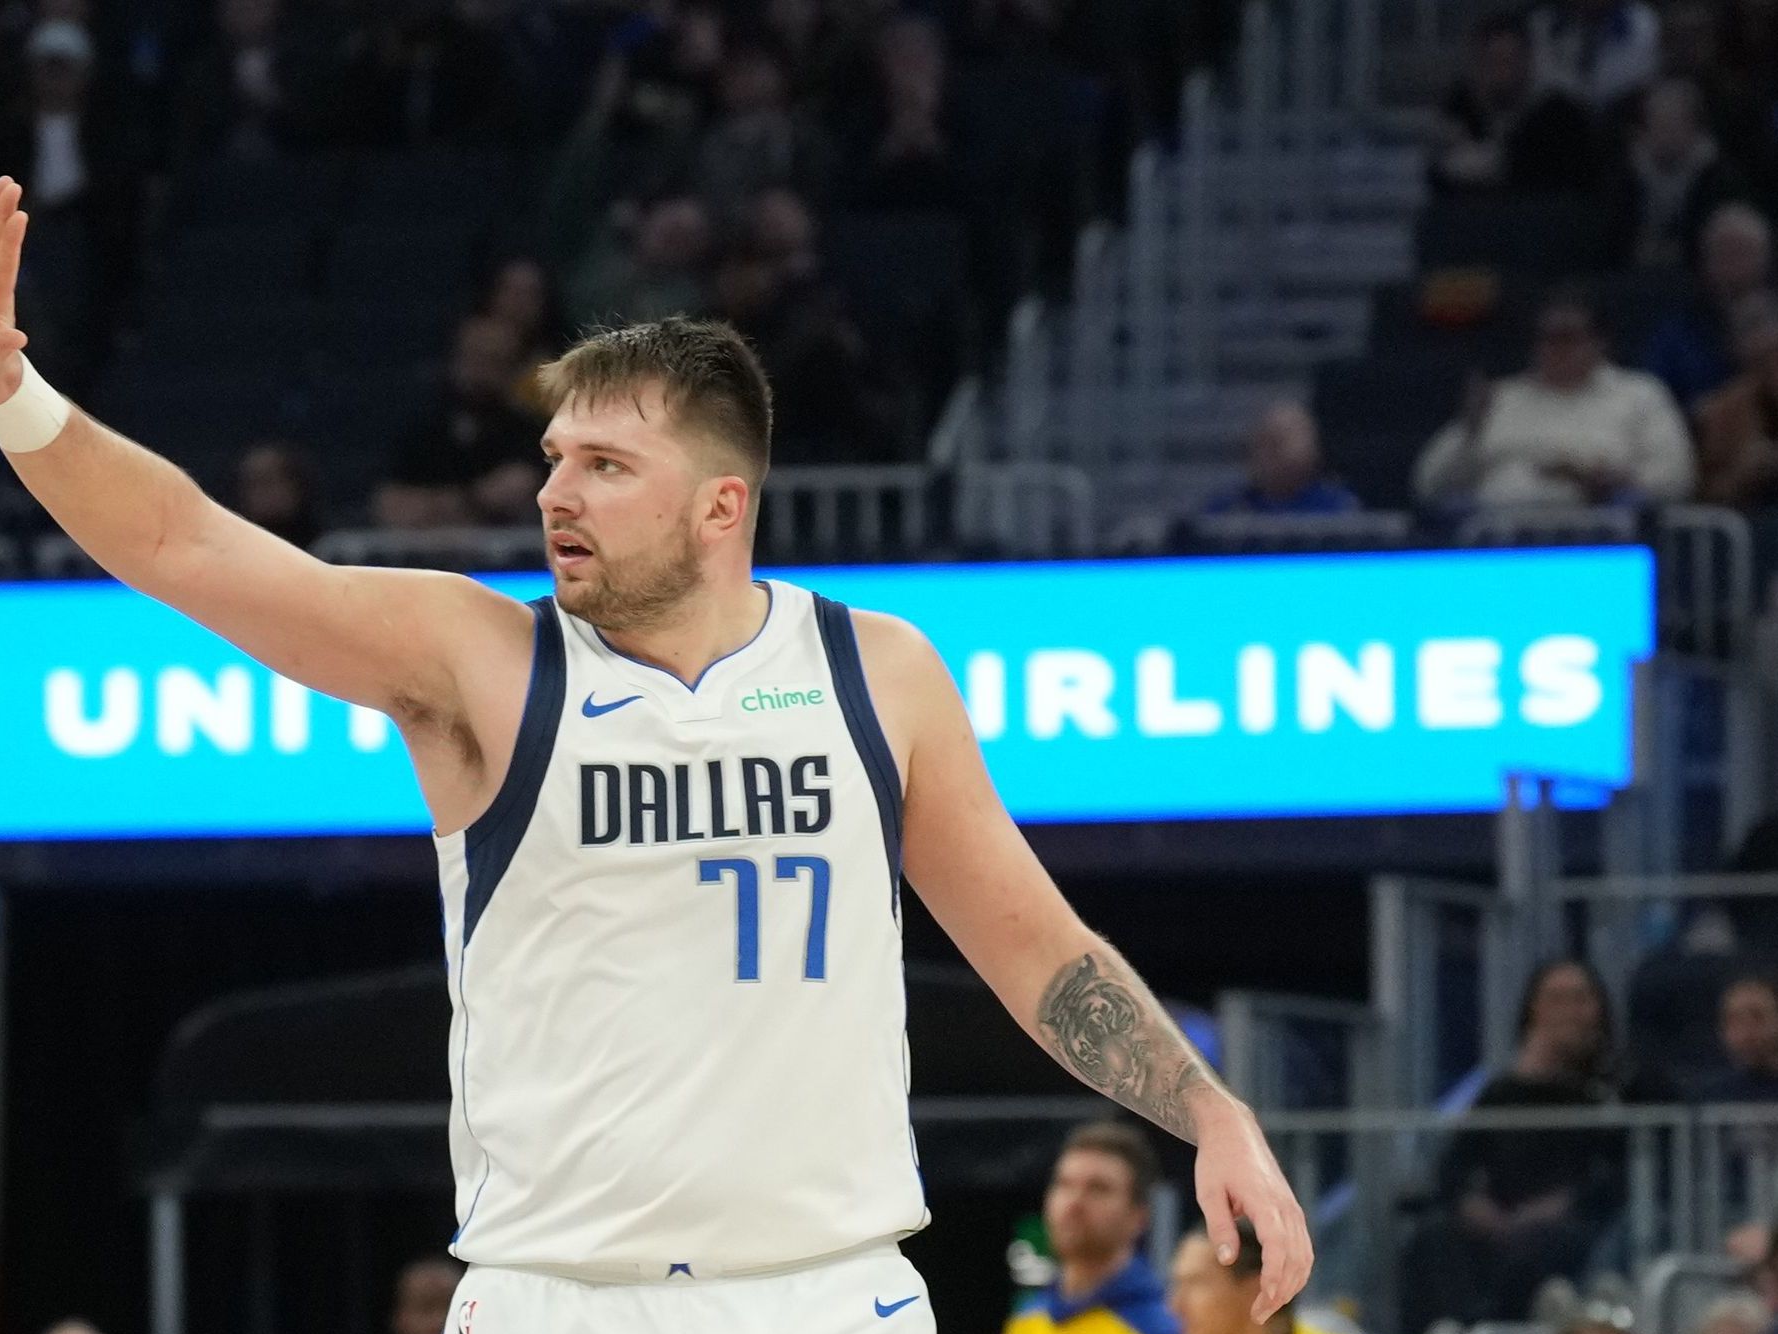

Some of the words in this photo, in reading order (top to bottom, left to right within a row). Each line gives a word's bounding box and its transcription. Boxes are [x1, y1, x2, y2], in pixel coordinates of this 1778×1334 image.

[44, 664, 388, 758] UNI
[967, 634, 1603, 740] IRLINES
[741, 686, 825, 713] chime
[578, 753, 834, 848] DALLAS
[697, 854, 832, 983] 77
